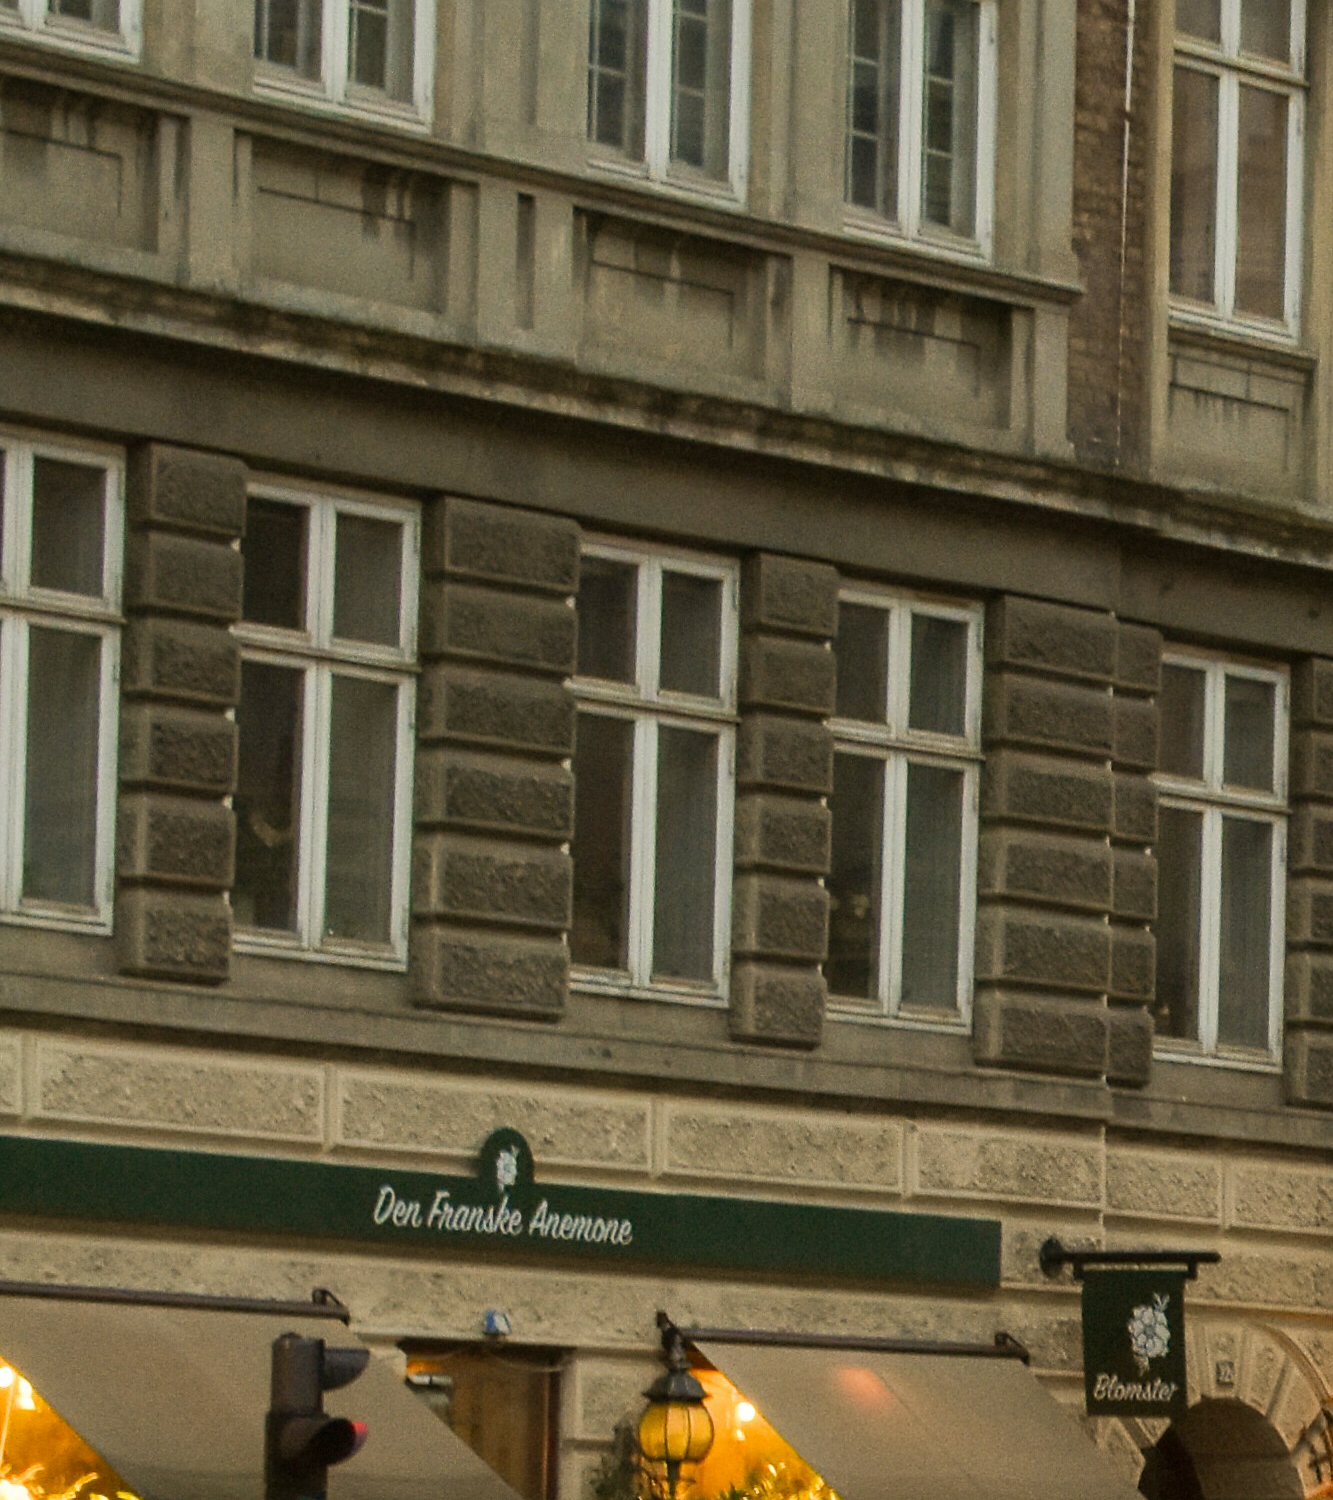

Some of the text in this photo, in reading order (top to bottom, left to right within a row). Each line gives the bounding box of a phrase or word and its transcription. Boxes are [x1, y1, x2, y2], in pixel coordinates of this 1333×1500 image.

[373, 1184, 634, 1245] Den Franske Anemone
[1093, 1372, 1178, 1401] Blomster
